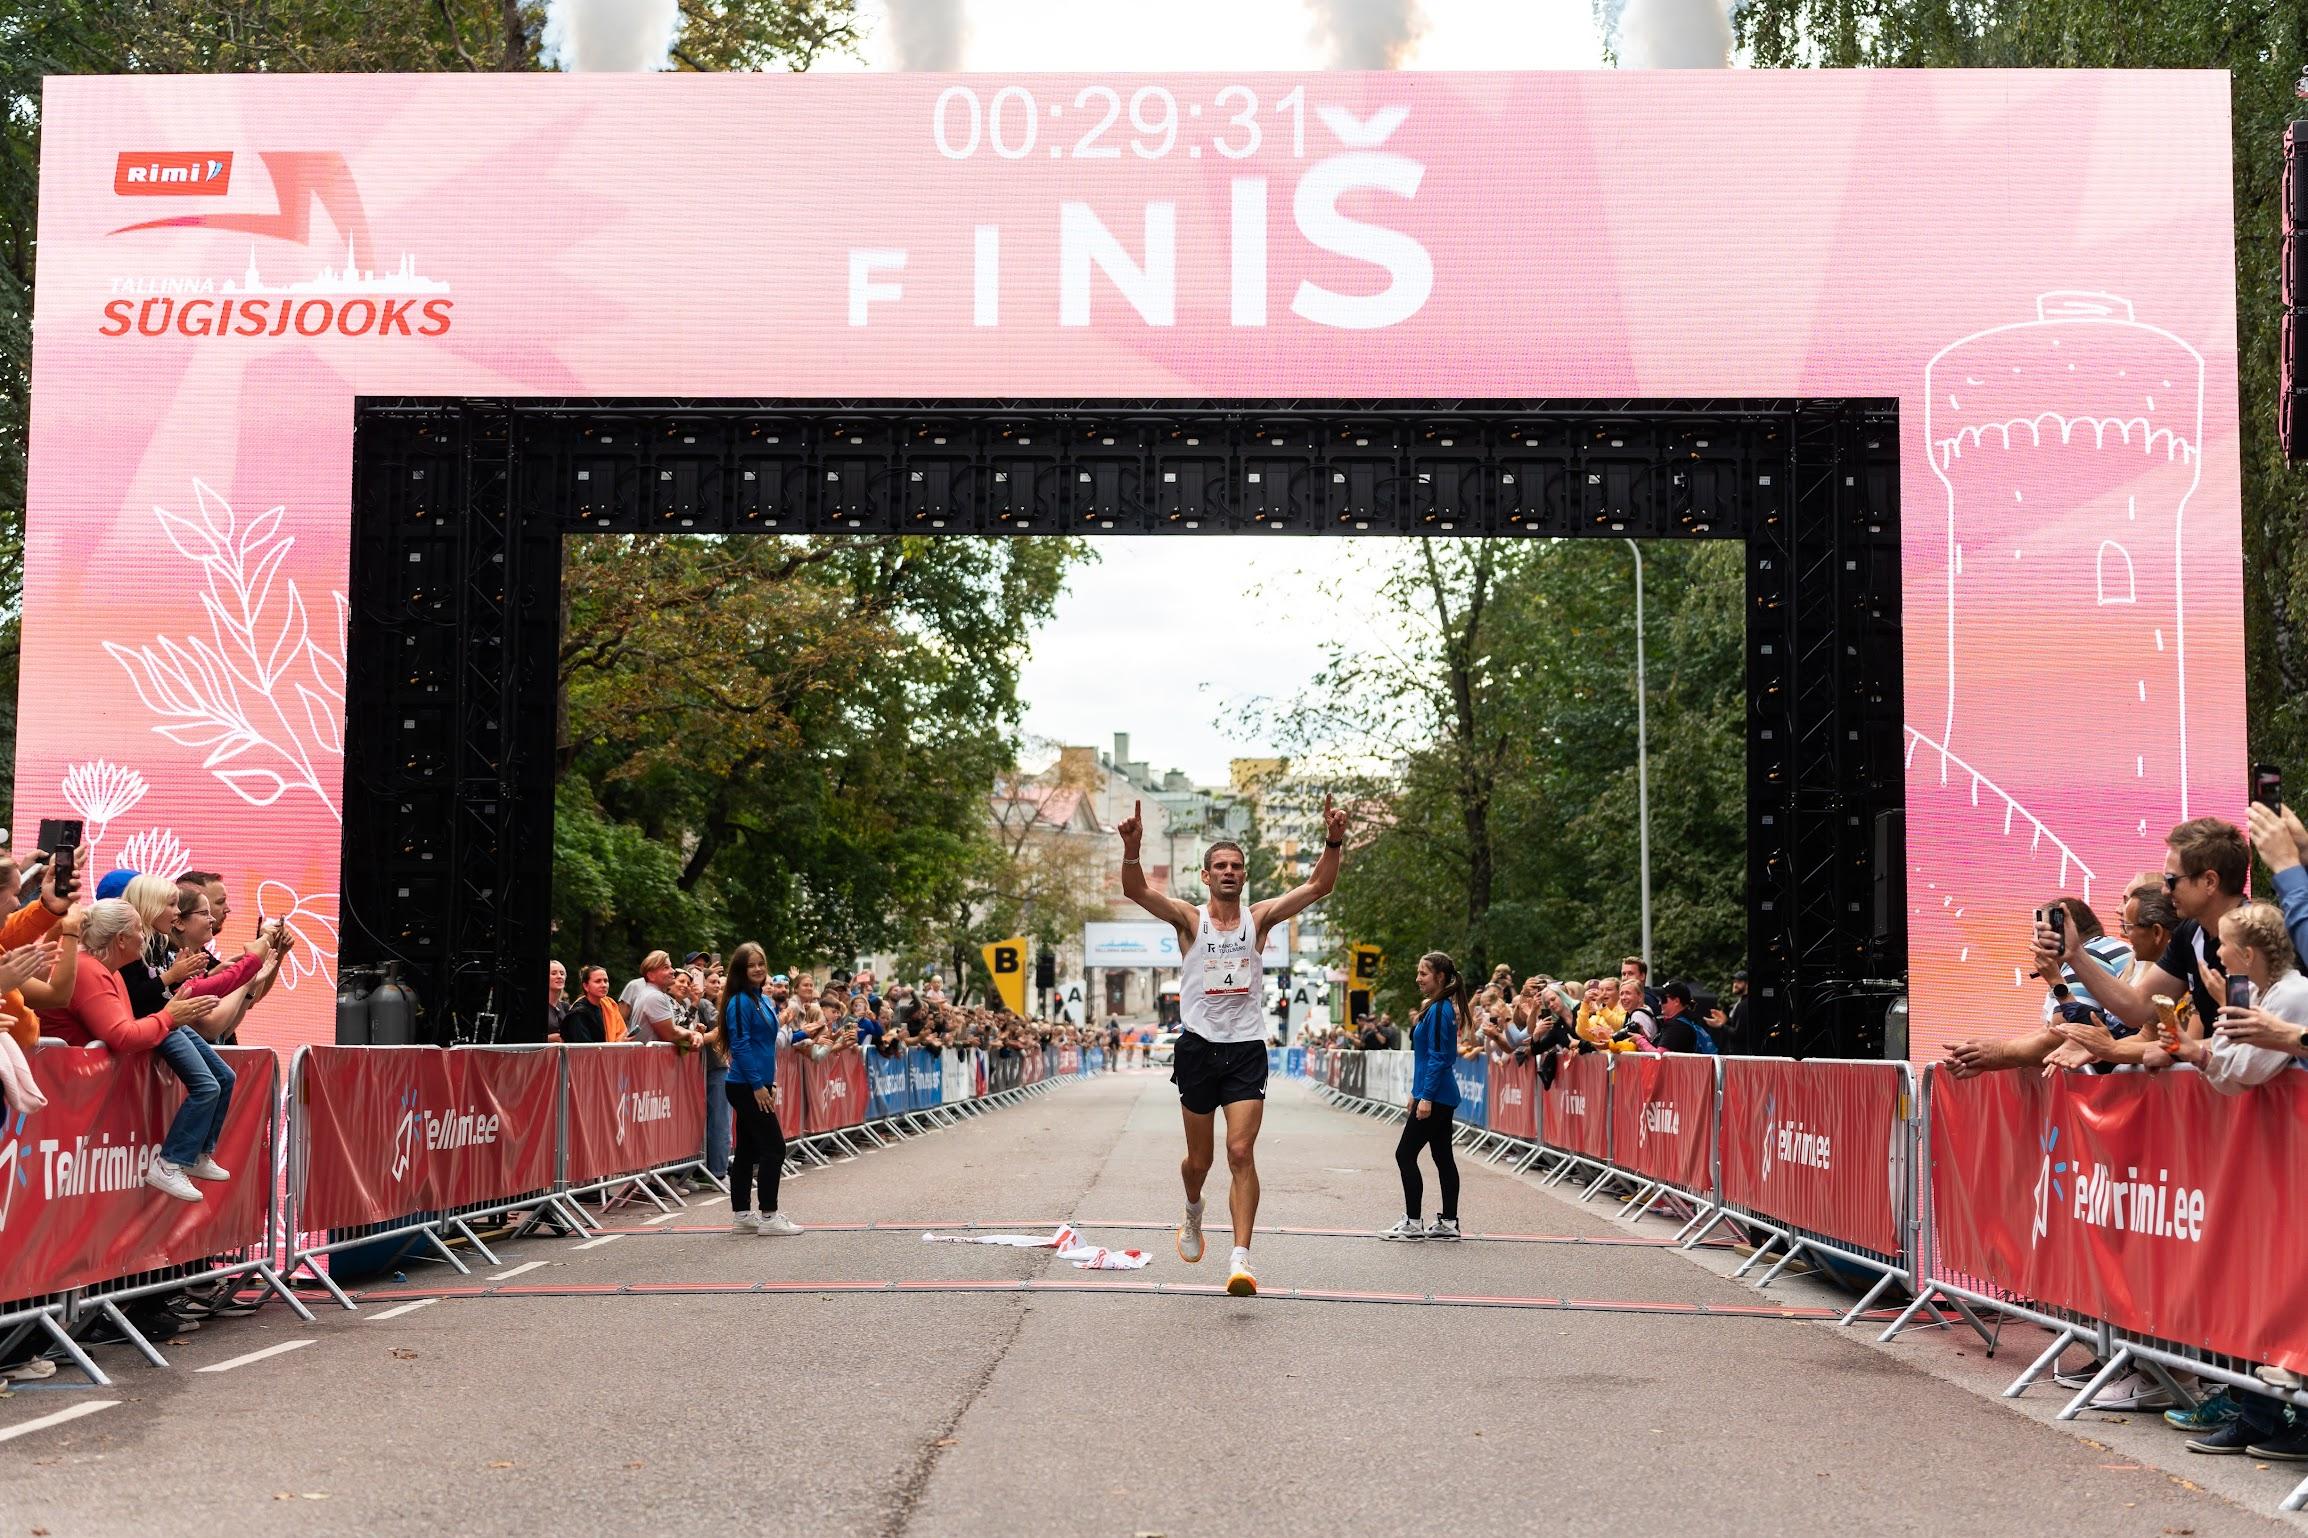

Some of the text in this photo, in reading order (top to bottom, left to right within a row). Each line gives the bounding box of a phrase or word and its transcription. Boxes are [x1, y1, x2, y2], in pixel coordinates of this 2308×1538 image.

[932, 84, 1306, 160] 00:29:31
[127, 163, 201, 184] Rimi
[108, 277, 216, 294] TALLINNA
[98, 297, 455, 337] SÜGISJOOKS
[995, 947, 1020, 973] B
[1223, 973, 1234, 986] 4
[1067, 987, 1083, 1003] A
[1293, 988, 1310, 1004] A
